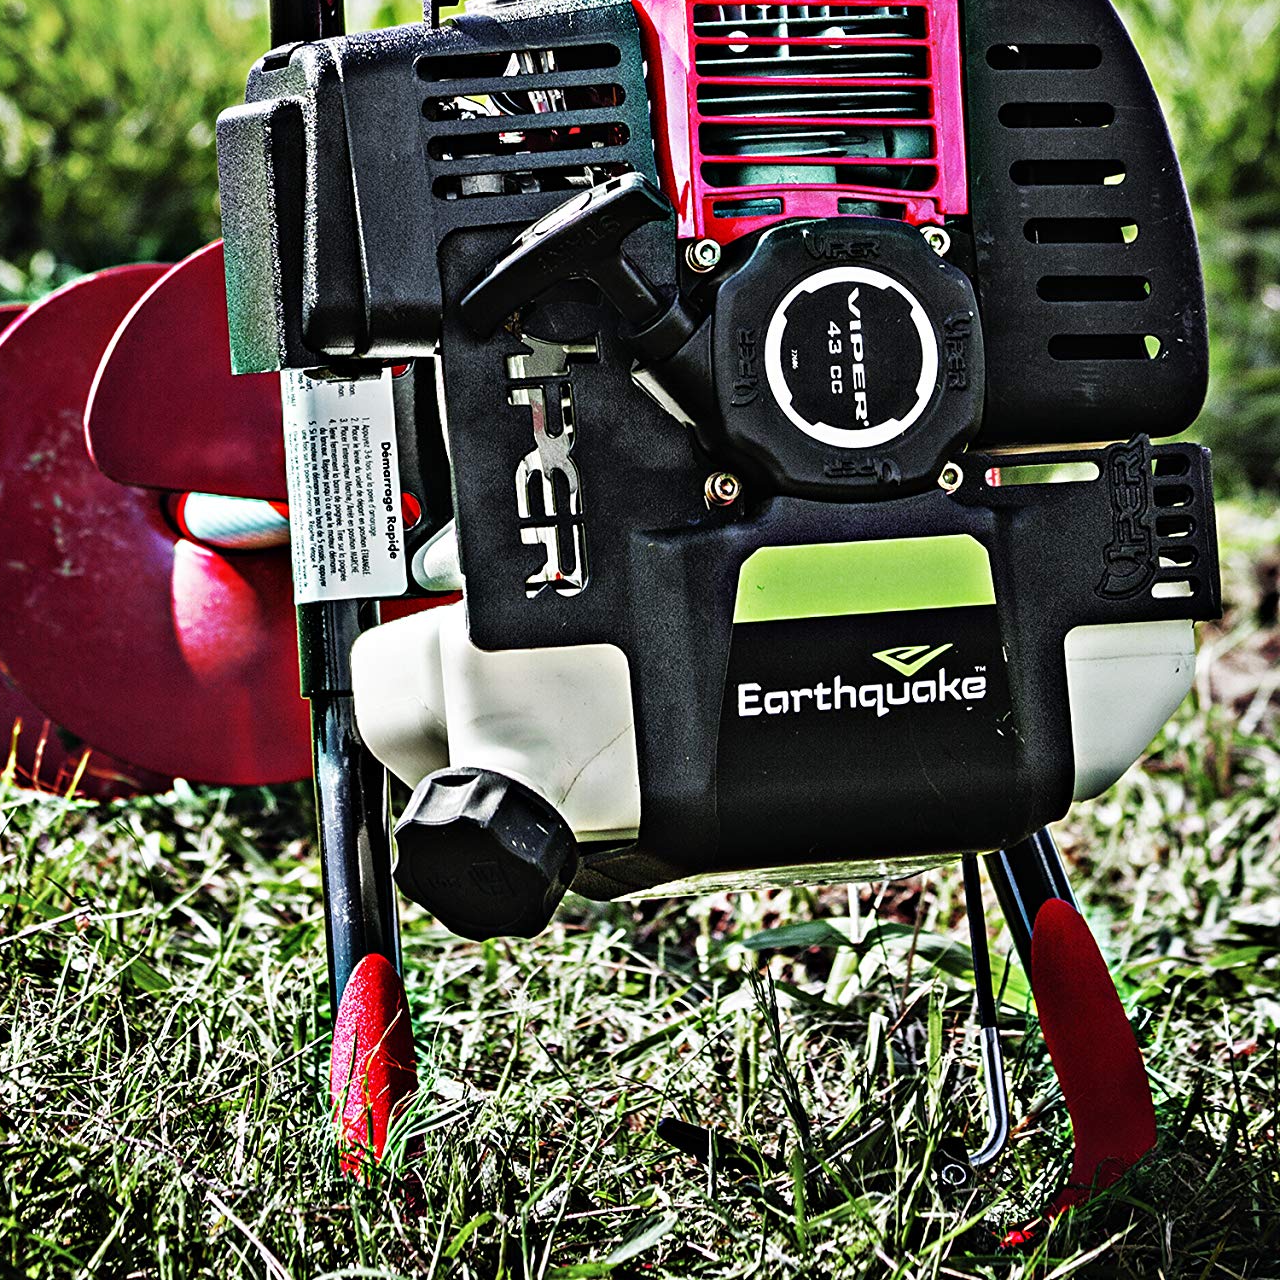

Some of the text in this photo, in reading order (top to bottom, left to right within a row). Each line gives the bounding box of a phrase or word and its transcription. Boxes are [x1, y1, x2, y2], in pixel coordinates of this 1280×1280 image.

[827, 320, 844, 395] 43 CC
[847, 287, 869, 423] VIPER
[329, 427, 337, 440] Tenir
[341, 426, 349, 442] Placer
[352, 425, 360, 441] Placer
[361, 425, 370, 448] Appuyez
[330, 441, 339, 471] fermement
[342, 444, 351, 479] l'interrupteur
[364, 450, 372, 459] 3-6
[321, 459, 330, 480] Répéter
[366, 461, 374, 471] fois
[322, 482, 332, 501] jusqu'à
[333, 480, 341, 494] barre
[366, 489, 375, 502] poire
[356, 499, 365, 516] départ
[381, 442, 400, 559] Démarrage Rapide
[325, 511, 333, 521] que
[337, 530, 346, 541] Tirer
[347, 528, 356, 549] position
[358, 526, 367, 548] position
[318, 565, 327, 587] appuyer
[338, 560, 347, 581] poignée
[737, 666, 987, 718] Earthquake
